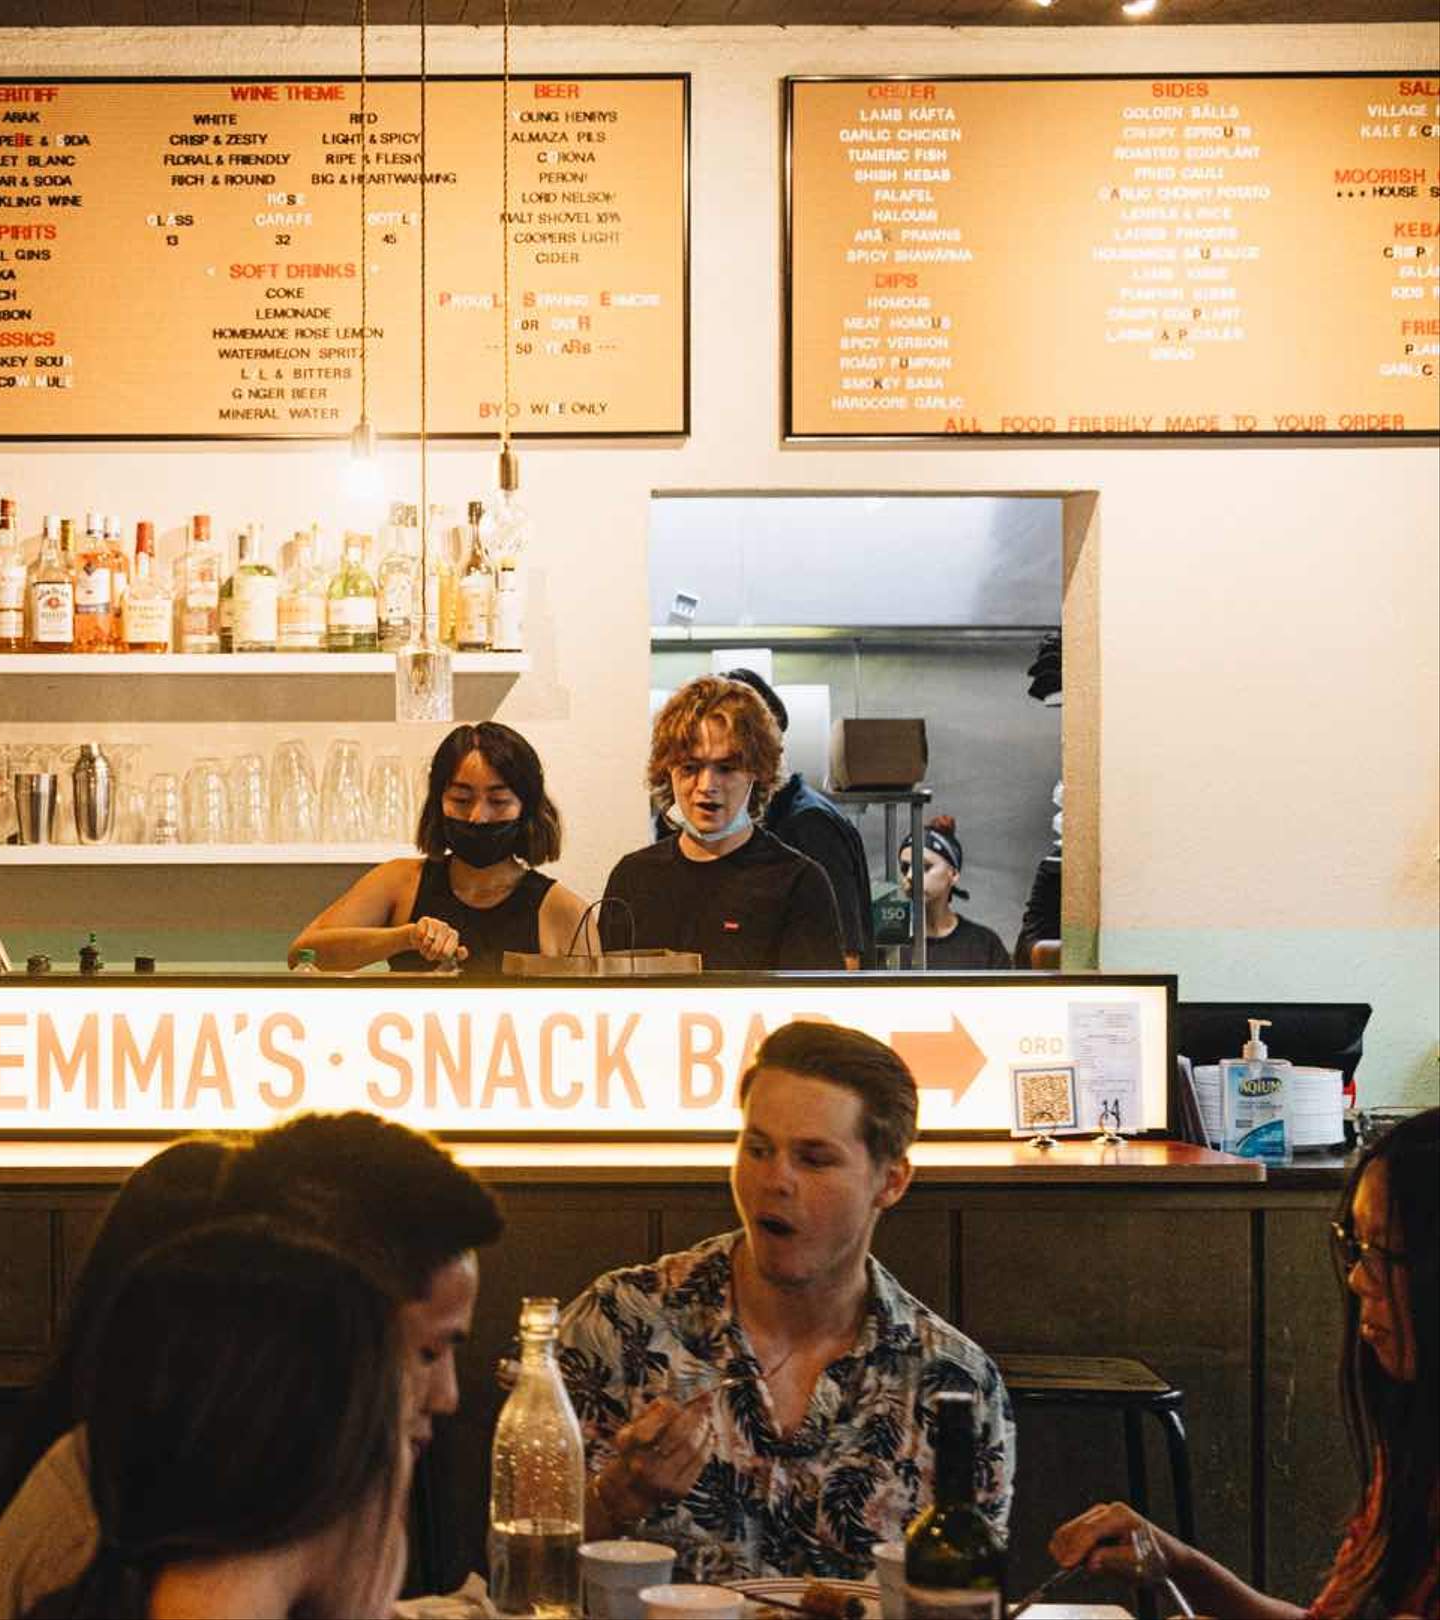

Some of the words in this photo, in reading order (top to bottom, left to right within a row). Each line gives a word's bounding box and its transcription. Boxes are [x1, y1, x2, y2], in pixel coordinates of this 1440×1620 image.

[230, 86, 278, 102] WINE
[286, 84, 346, 101] THEME
[533, 83, 580, 100] BEER
[1151, 82, 1210, 98] SIDES
[1398, 80, 1439, 97] SAL
[564, 110, 618, 123] HENRYS
[859, 108, 902, 122] LAMB
[1367, 104, 1428, 118] VILLAGE
[2, 112, 41, 124] ARAK
[193, 114, 238, 126] WHITE
[350, 112, 378, 125] RED
[510, 132, 569, 143] ALMAZA
[839, 128, 891, 142] GARLIC
[897, 128, 961, 142] CHICKEN
[1360, 124, 1401, 138] KALE
[40, 136, 49, 146] &
[56, 134, 91, 147] SODA
[169, 134, 209, 146] CRISP
[213, 135, 222, 146] &
[225, 134, 268, 146] ZESTY
[322, 132, 362, 145] LIGHT
[369, 133, 378, 144] &
[380, 132, 420, 145] SPICY
[27, 155, 76, 167] BLANC
[164, 154, 213, 166] FLORAL
[215, 155, 224, 165] &
[228, 154, 291, 166] FRIENDLY
[325, 153, 357, 165] RIPE
[376, 153, 424, 165] FLESHY
[847, 148, 910, 162] TUMERIC
[914, 148, 948, 162] FISH
[20, 176, 29, 187] &
[33, 175, 72, 187] SODA
[171, 174, 205, 187] RICH
[210, 175, 220, 186] &
[224, 174, 276, 186] ROUND
[311, 173, 335, 185] BIG
[339, 174, 348, 184] &
[351, 173, 457, 186] HEARTWARMING
[903, 168, 952, 182] KEBAB
[1333, 168, 1426, 184] MOORISH
[521, 191, 558, 204] LORD
[1373, 186, 1418, 198] HOUSE
[48, 195, 82, 207] WINE
[499, 212, 534, 224] MALT
[537, 211, 590, 224] SHOVEL
[166, 235, 179, 247] 13
[275, 234, 292, 246] 32
[513, 231, 577, 243] COOPERS
[581, 231, 620, 243] LIGHT
[15, 249, 51, 261] GINS
[535, 252, 579, 265] CIDER
[229, 263, 279, 279] SOFT
[286, 263, 357, 279] DRINKS
[874, 273, 919, 289] DIPS
[265, 287, 305, 299] COKE
[255, 308, 332, 320] LEMONADE
[212, 328, 289, 340] HOMEMADE
[294, 328, 332, 340] ROSE
[336, 327, 385, 340] LEMON
[218, 348, 311, 360] WATERMELON
[318, 347, 369, 360] SPRITZ
[514, 341, 533, 355] 50
[34, 355, 72, 367] SOUR
[275, 369, 284, 380] &
[292, 368, 353, 380] BITTERS
[35, 376, 72, 388] MULE
[231, 387, 286, 400] GNGER
[291, 388, 328, 399] BEER
[218, 408, 280, 421] MINERAL
[288, 407, 340, 420] WATER
[479, 400, 521, 418] BYO
[570, 401, 609, 416] ONLY
[944, 417, 982, 432] ALL
[1000, 416, 1056, 432] FOOD
[1067, 415, 1153, 432] FRESHLY
[1164, 415, 1220, 432] MADE
[1234, 414, 1258, 431] TO
[1273, 414, 1328, 431] YOUR
[1338, 414, 1406, 431] ORDER
[366, 1011, 646, 1111] SNACK
[679, 1011, 833, 1110] BA
